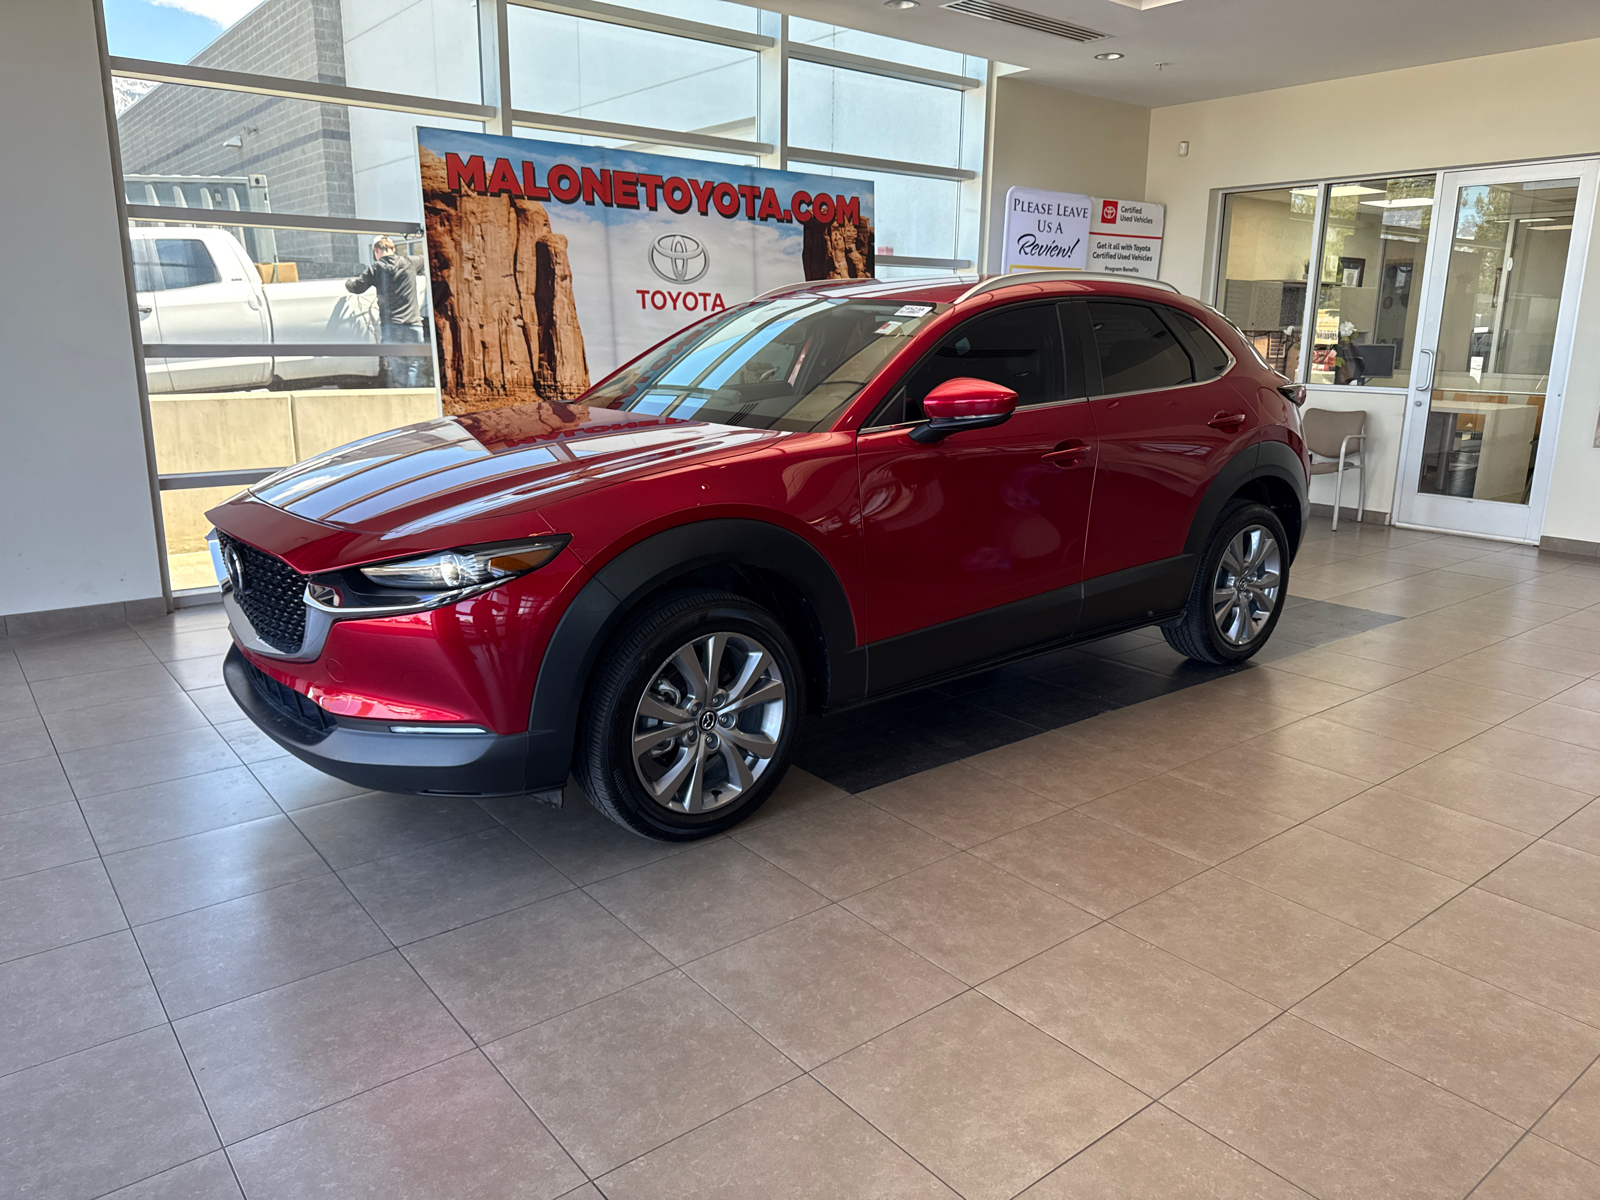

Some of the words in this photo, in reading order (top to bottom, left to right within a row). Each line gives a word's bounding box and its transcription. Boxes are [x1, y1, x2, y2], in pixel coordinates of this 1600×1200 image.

[445, 152, 861, 226] MALONETOYOTA.COM
[1013, 198, 1053, 215] PLEASE
[1057, 204, 1088, 219] LEAVE
[1121, 206, 1142, 214] Certified
[1055, 222, 1063, 234] A
[1133, 216, 1153, 224] Vehicles
[1017, 234, 1080, 258] Review!
[1133, 244, 1151, 252] Toyota
[636, 289, 725, 312] TOYOTA
